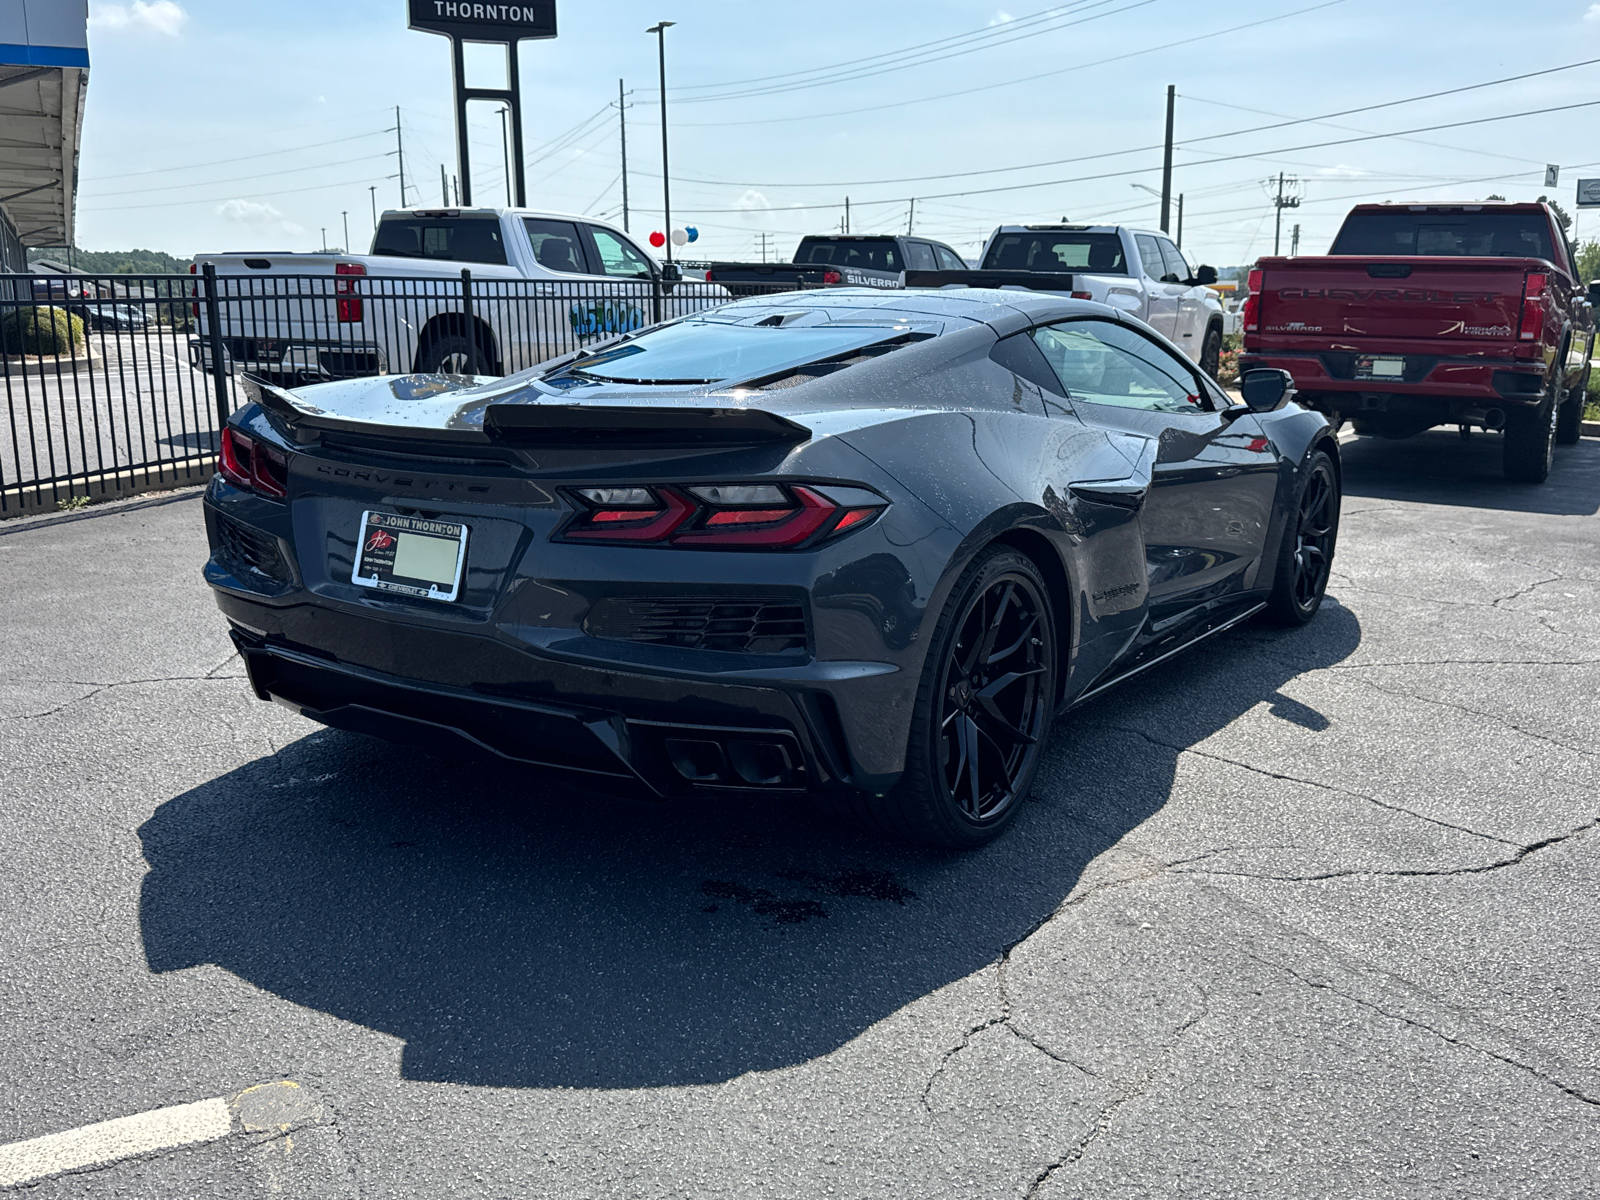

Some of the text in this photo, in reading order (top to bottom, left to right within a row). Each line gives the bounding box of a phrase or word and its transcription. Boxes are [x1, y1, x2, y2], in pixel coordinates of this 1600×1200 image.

[434, 1, 534, 22] THORNTON
[847, 274, 900, 288] SILVERAD
[1279, 288, 1502, 304] CHEVROLET
[317, 464, 492, 493] CORVETTE
[386, 516, 461, 536] JOHN THORNTON
[388, 584, 417, 594] CHEVROLET
